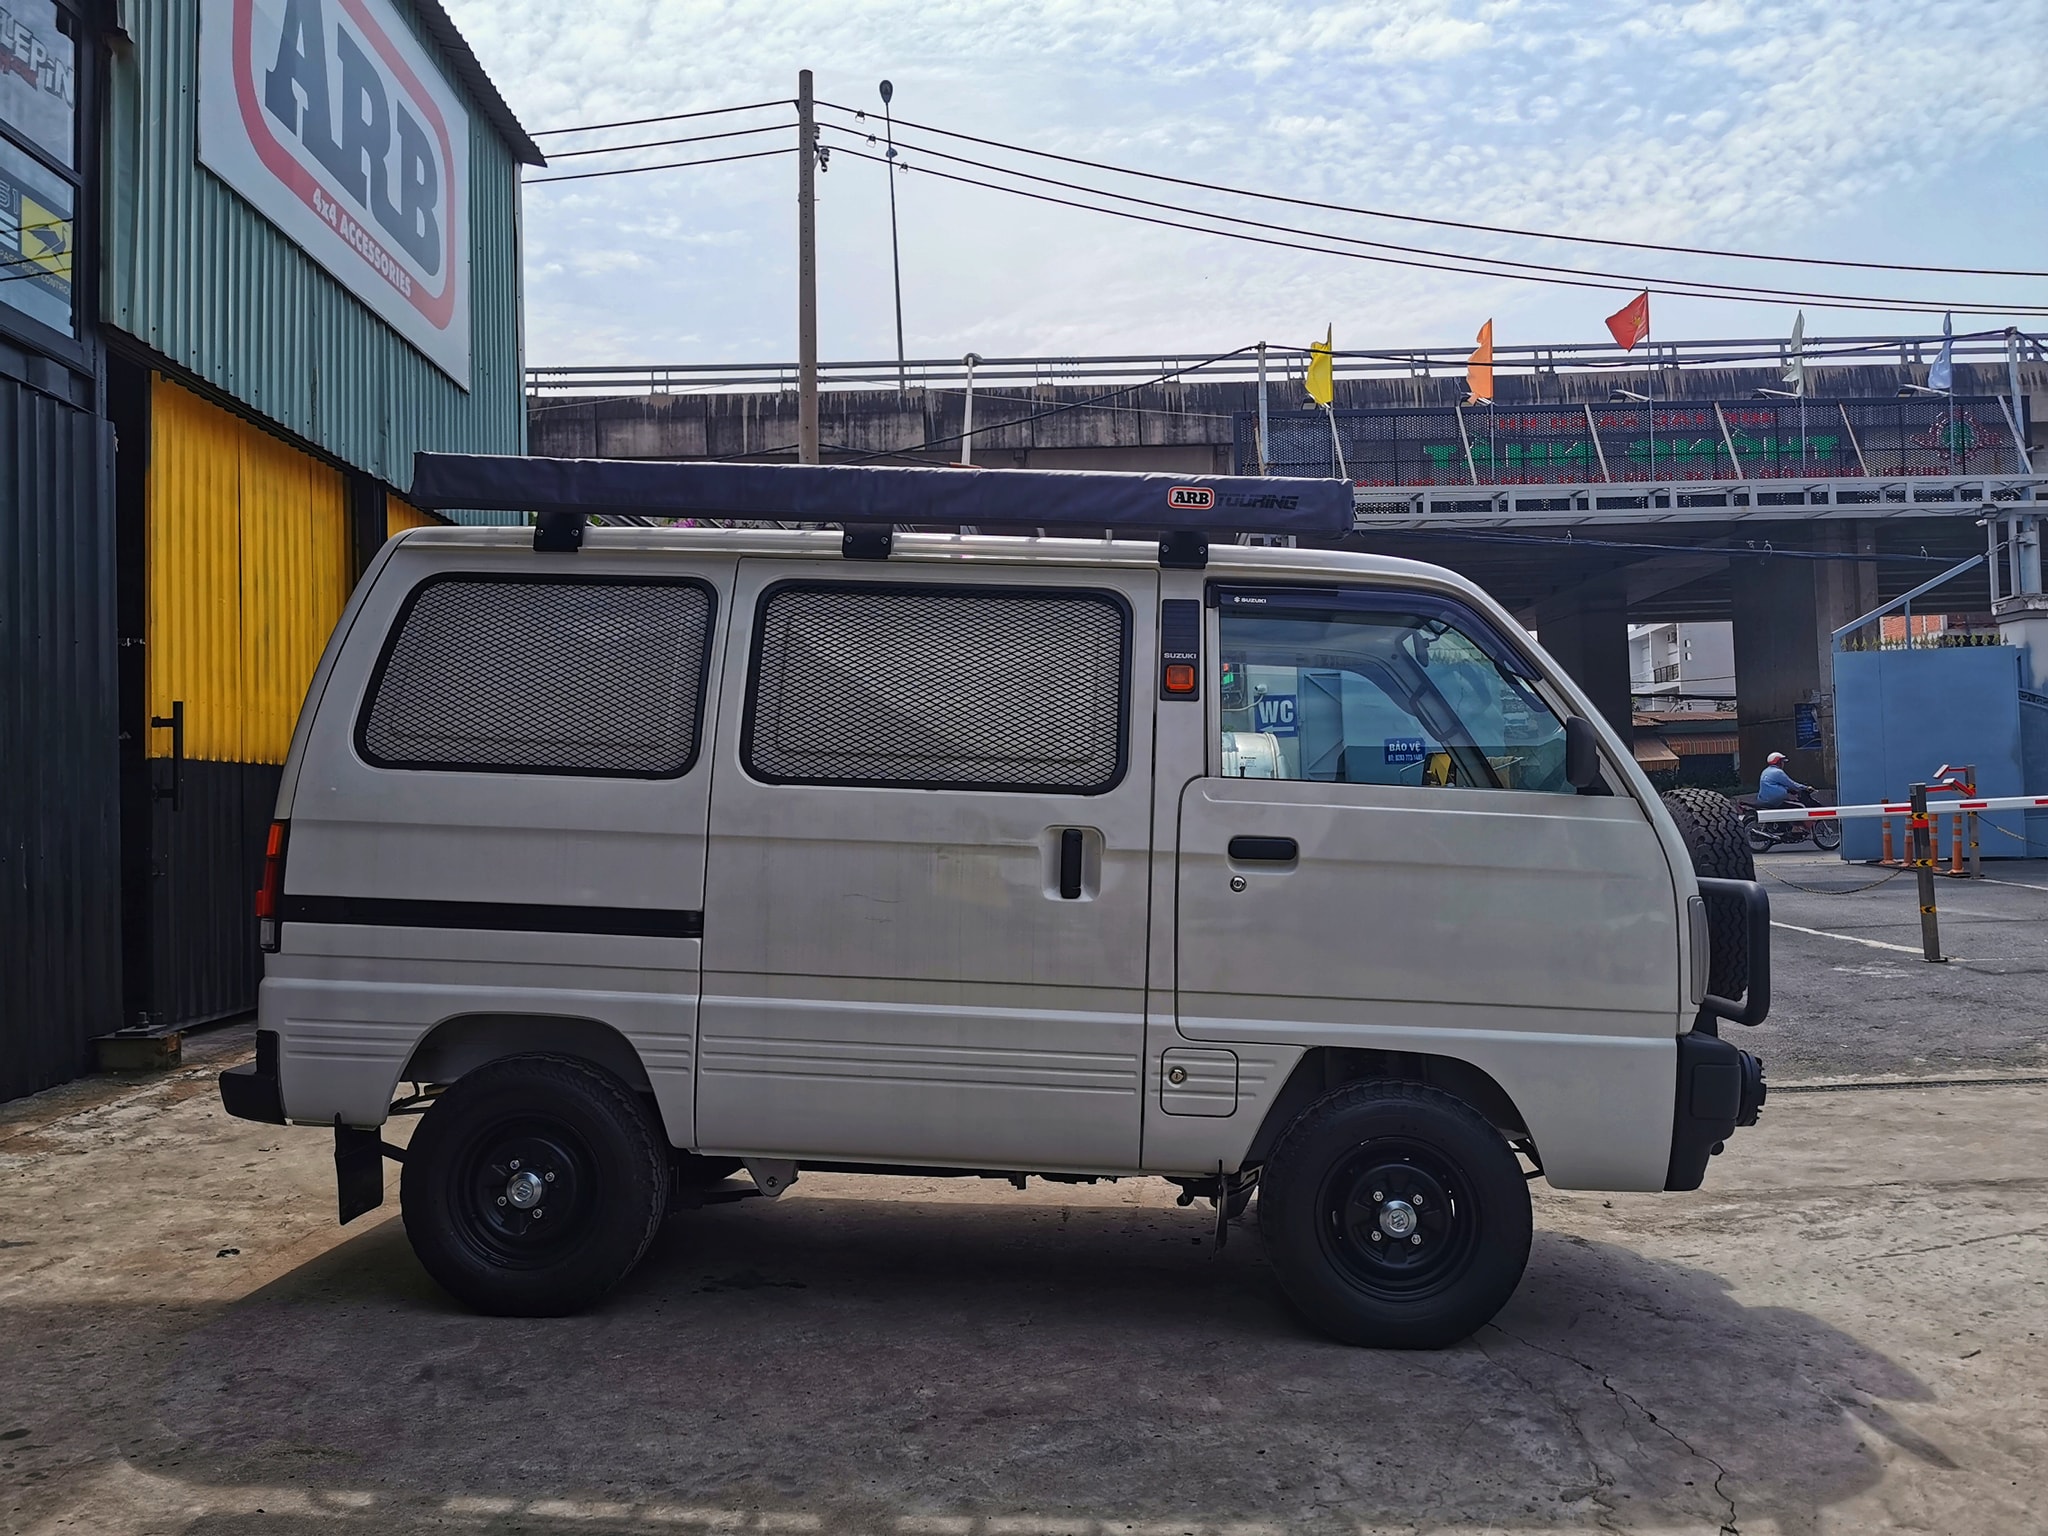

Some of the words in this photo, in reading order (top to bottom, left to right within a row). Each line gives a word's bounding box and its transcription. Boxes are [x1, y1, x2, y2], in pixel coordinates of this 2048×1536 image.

[264, 0, 441, 277] ARB
[313, 188, 337, 227] 4x4
[340, 213, 412, 298] ACCESSORIES
[1173, 491, 1209, 505] ARB
[1217, 492, 1299, 510] TOURING
[1258, 699, 1294, 724] WC
[1388, 740, 1407, 752] BẢO
[1409, 740, 1421, 752] VỆ
